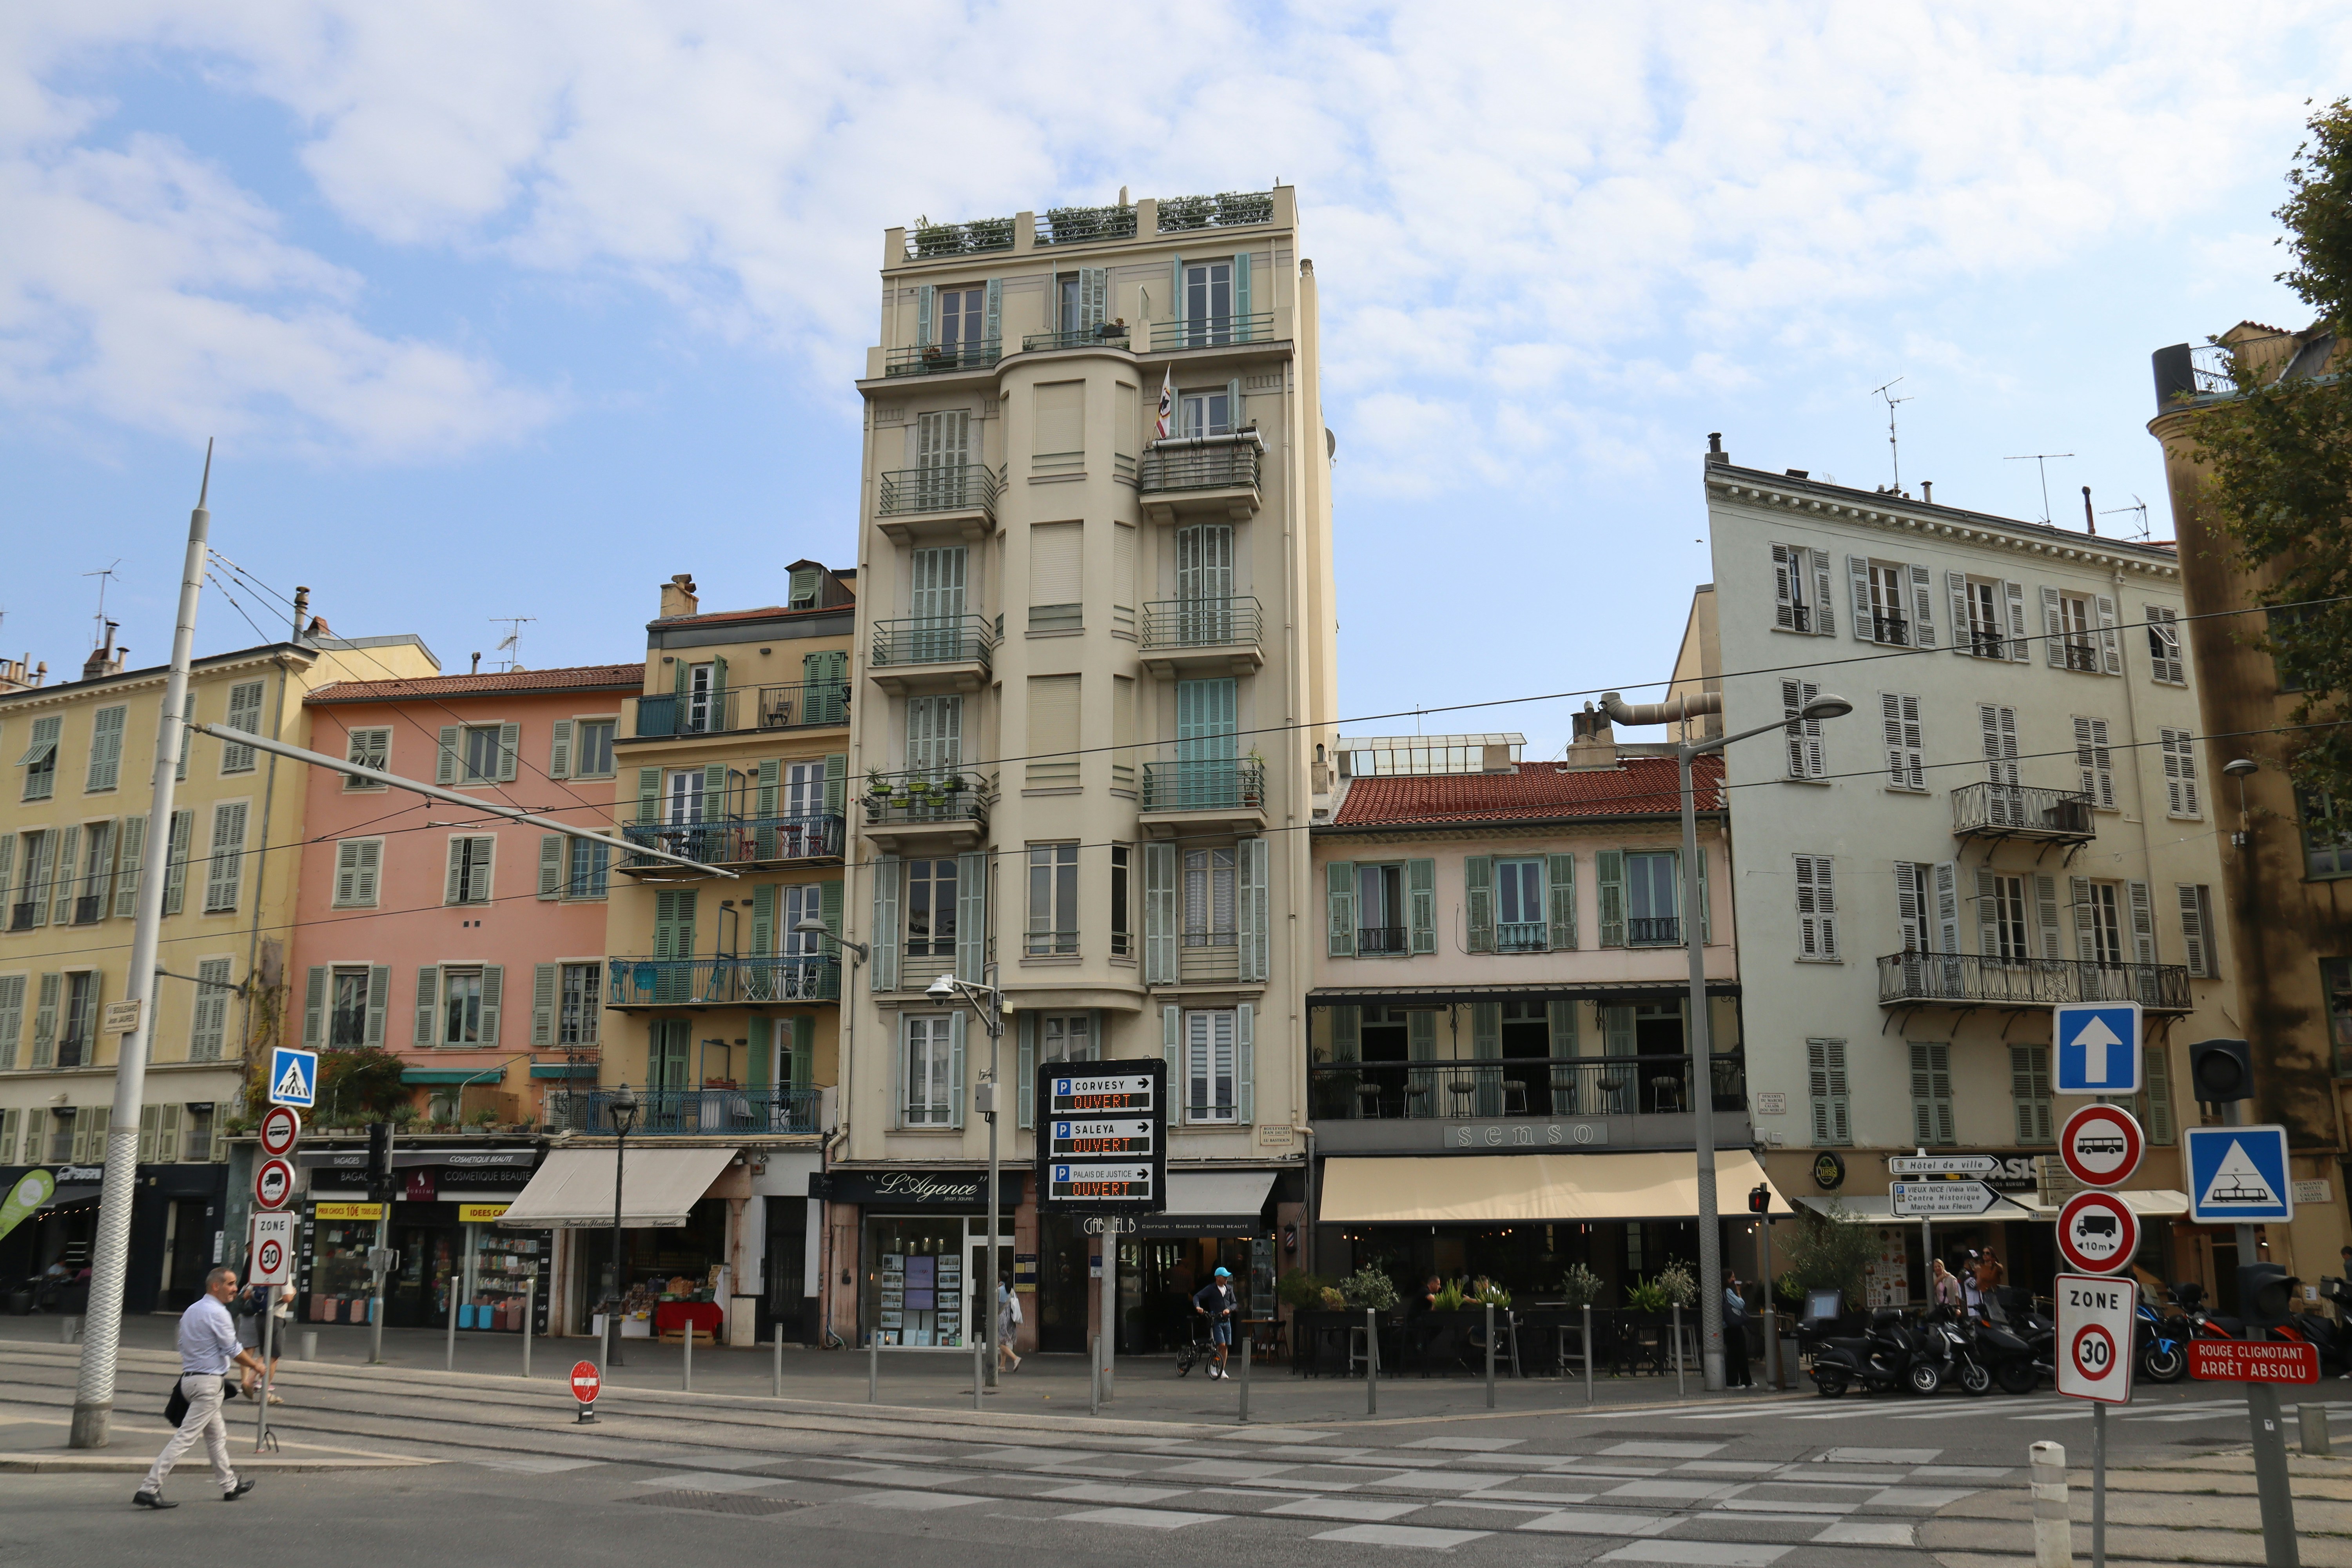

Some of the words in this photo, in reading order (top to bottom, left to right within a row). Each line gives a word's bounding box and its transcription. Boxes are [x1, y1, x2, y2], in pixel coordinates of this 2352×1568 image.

[1075, 1080, 1125, 1091] CORVESY
[1074, 1094, 1130, 1109] OUVERT
[1075, 1125, 1114, 1134] SALEYA
[1458, 1124, 1593, 1146] senso
[1074, 1138, 1130, 1152] OUVERT
[445, 1171, 498, 1181] COSMETIQUE
[501, 1171, 531, 1181] BEAUTE
[1073, 1183, 1129, 1196] OUVERT
[1939, 1194, 1980, 1203] Historique
[347, 1206, 359, 1217] 10€
[260, 1220, 285, 1231] ZONE
[262, 1249, 278, 1264] 30
[2070, 1290, 2119, 1310] ZONE
[2081, 1339, 2107, 1365] 30
[2199, 1344, 2233, 1357] ROUGE
[2238, 1346, 2303, 1360] CLIGNOTANT
[2200, 1359, 2243, 1376] ARRÊT
[2250, 1363, 2306, 1379] ABSOLU
